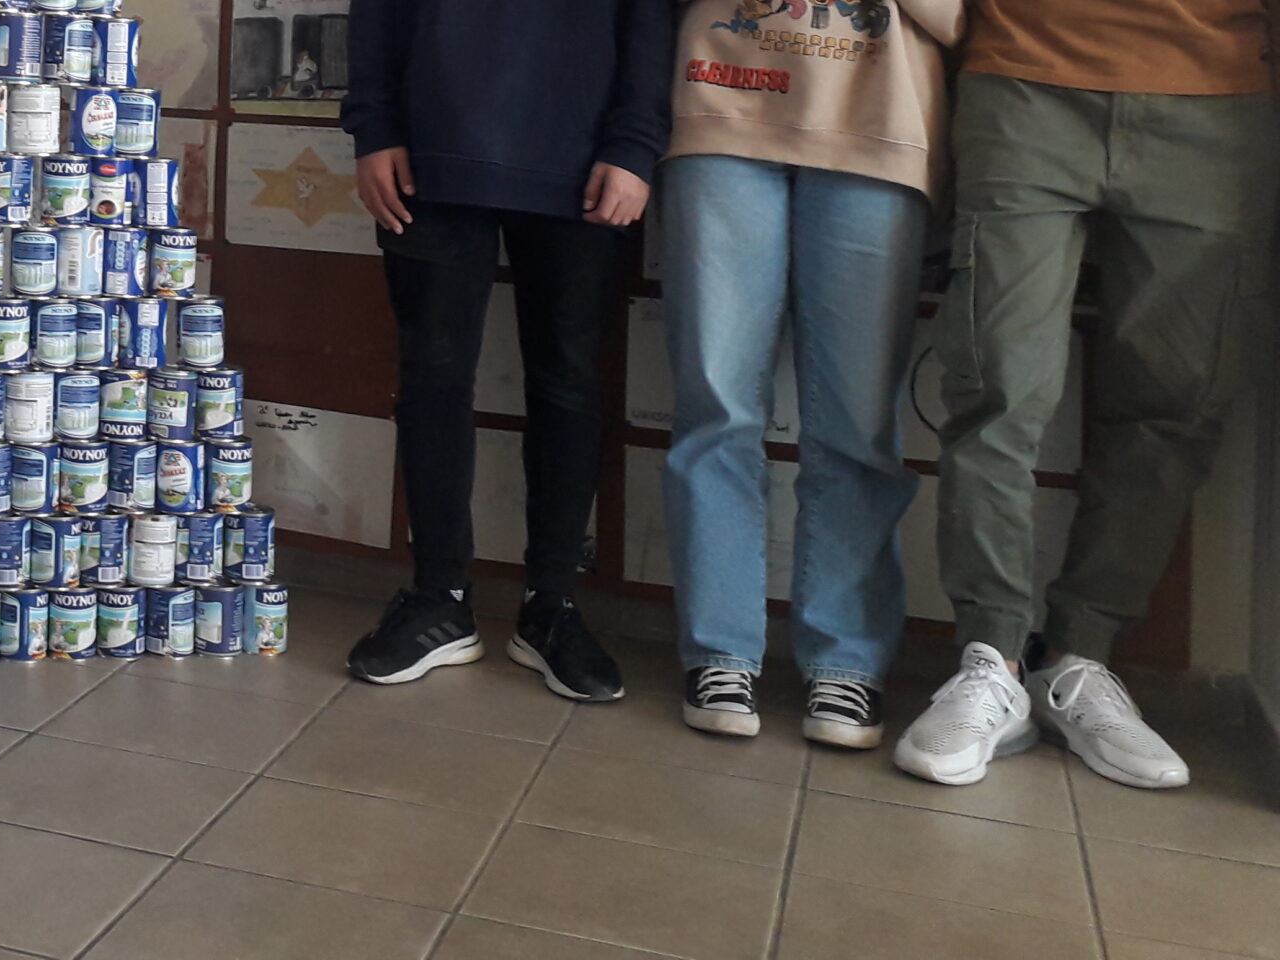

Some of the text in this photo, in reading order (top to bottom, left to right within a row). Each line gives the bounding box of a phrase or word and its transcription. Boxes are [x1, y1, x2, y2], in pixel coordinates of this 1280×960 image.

[43, 161, 89, 174] NOYNOY
[200, 377, 232, 388] YNOY
[63, 447, 108, 461] NOYNOY
[100, 594, 135, 606] YNOY
